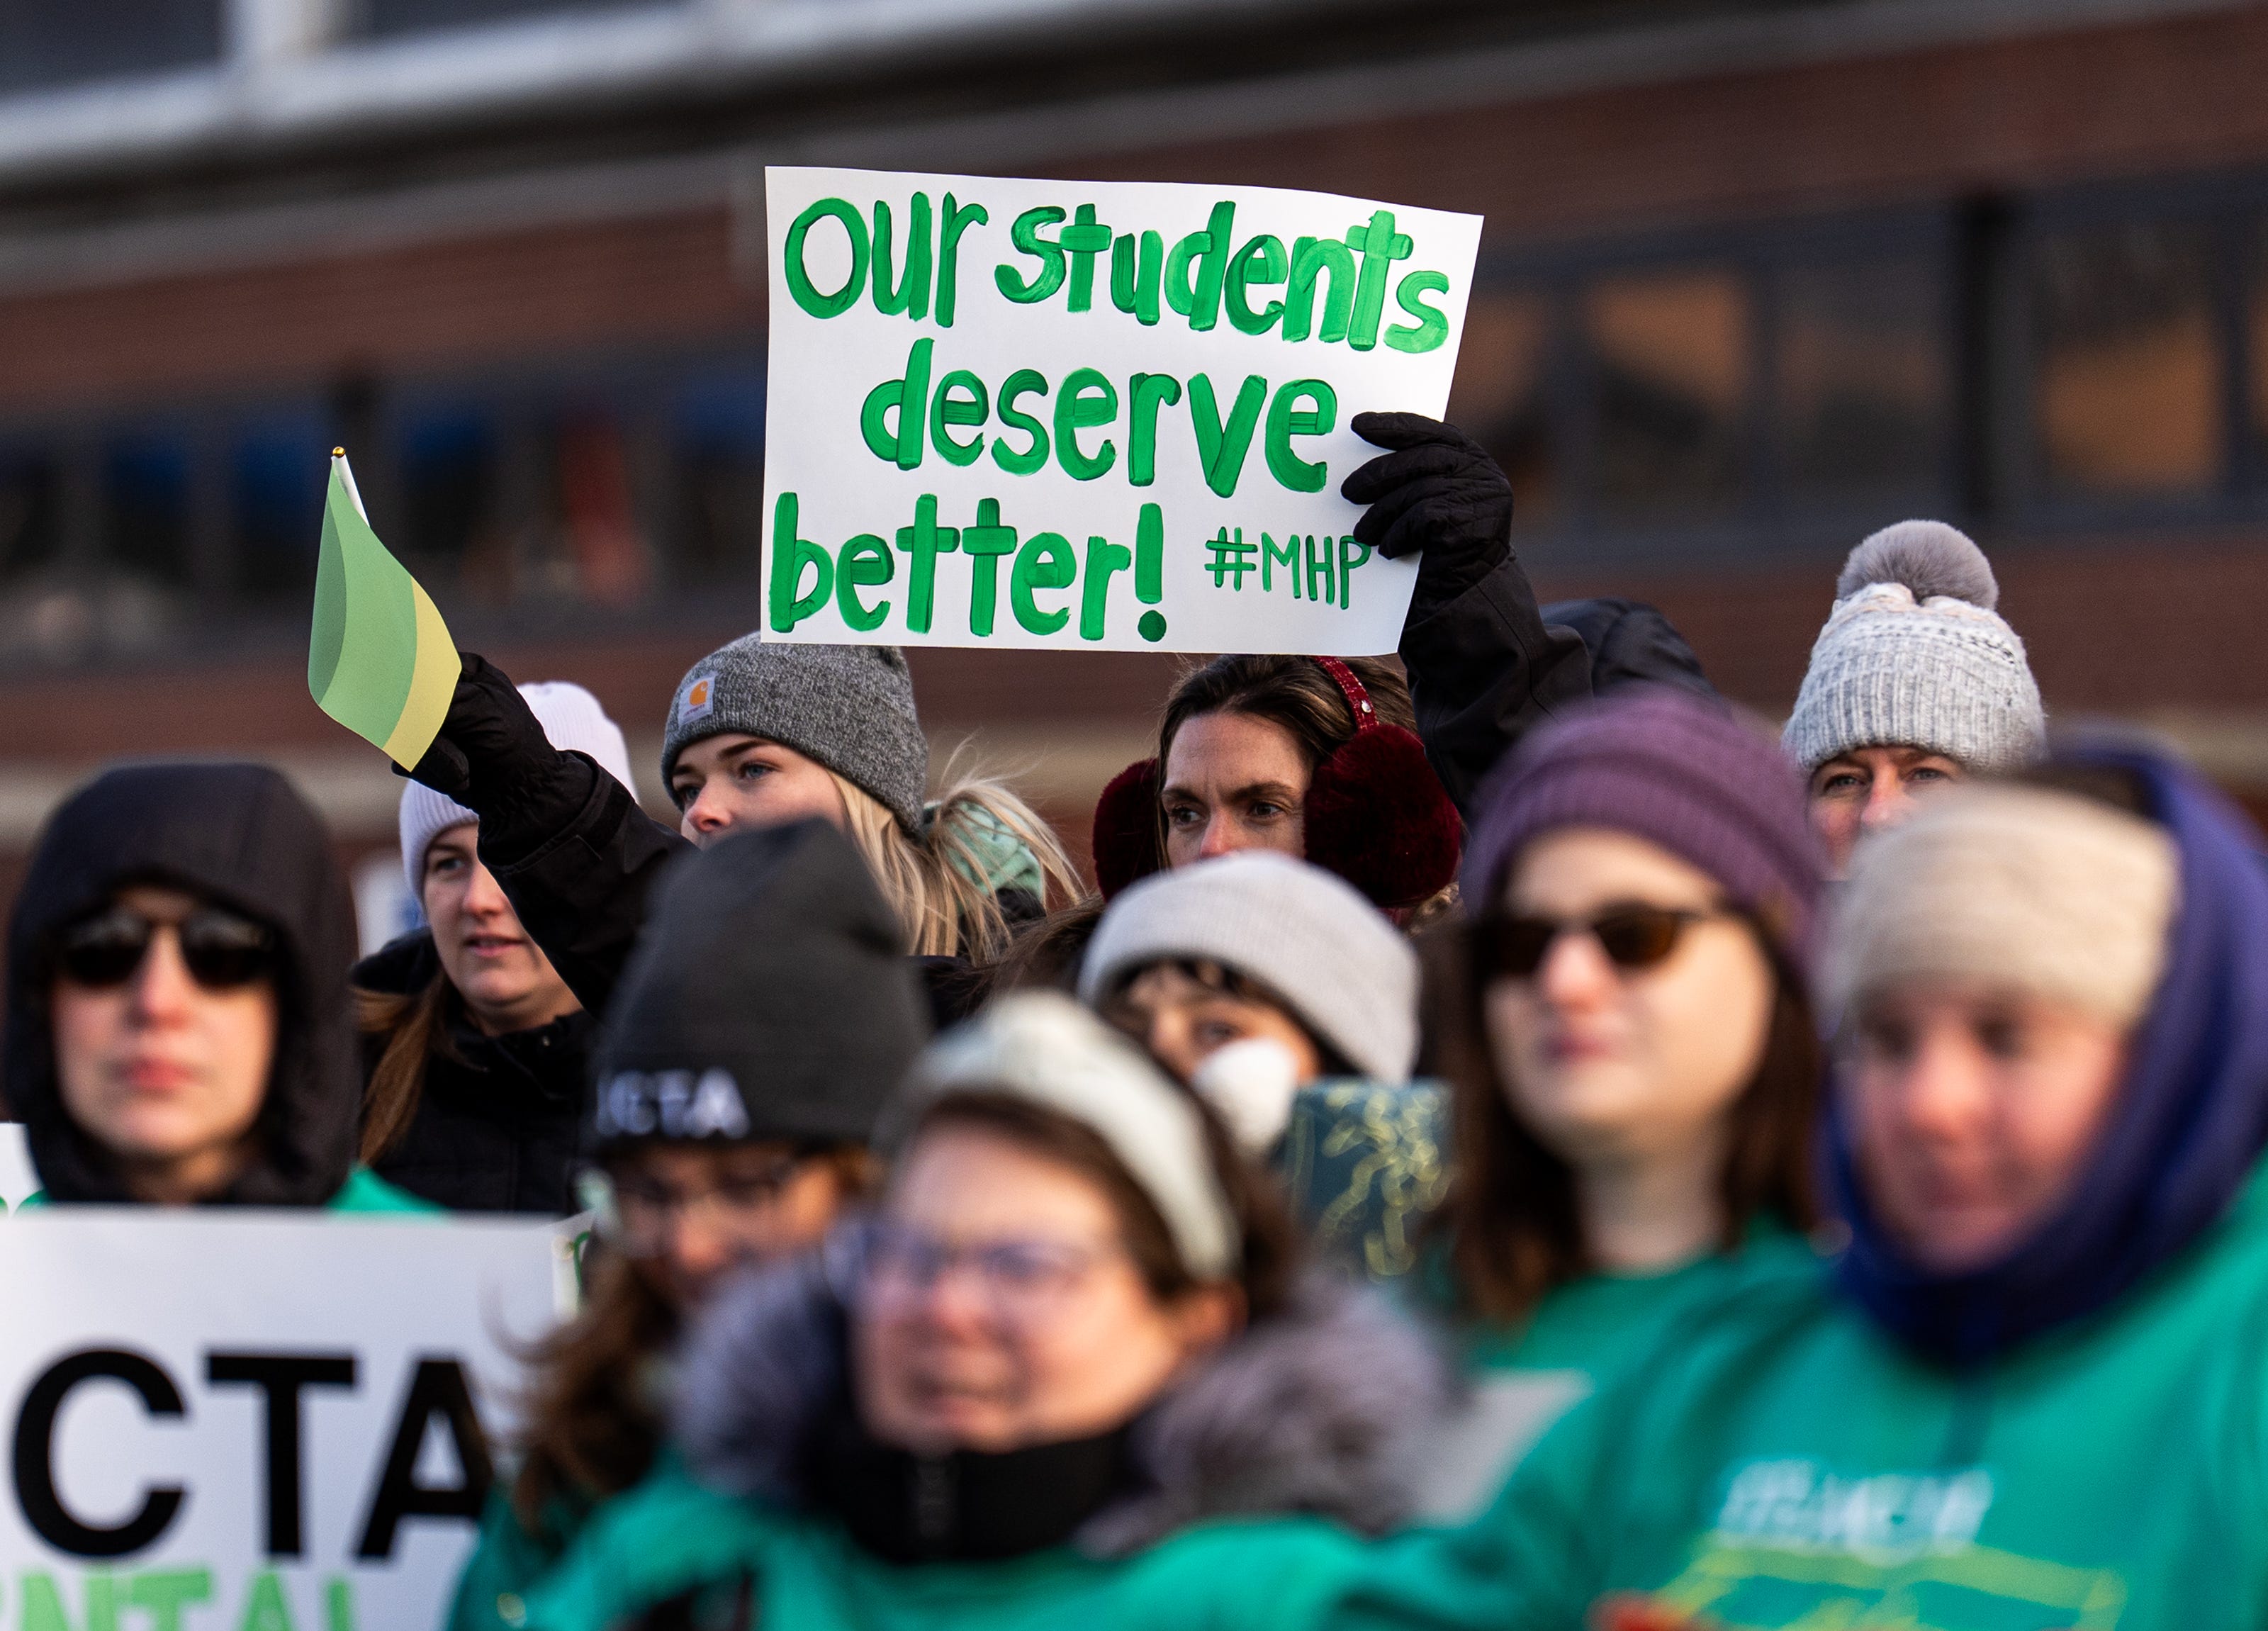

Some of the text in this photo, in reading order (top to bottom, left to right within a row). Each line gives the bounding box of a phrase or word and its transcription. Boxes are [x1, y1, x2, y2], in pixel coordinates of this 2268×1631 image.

[785, 191, 989, 327] Our
[860, 337, 1338, 498] deserve
[768, 491, 1167, 641] better!
[1205, 526, 1371, 609] #MHP
